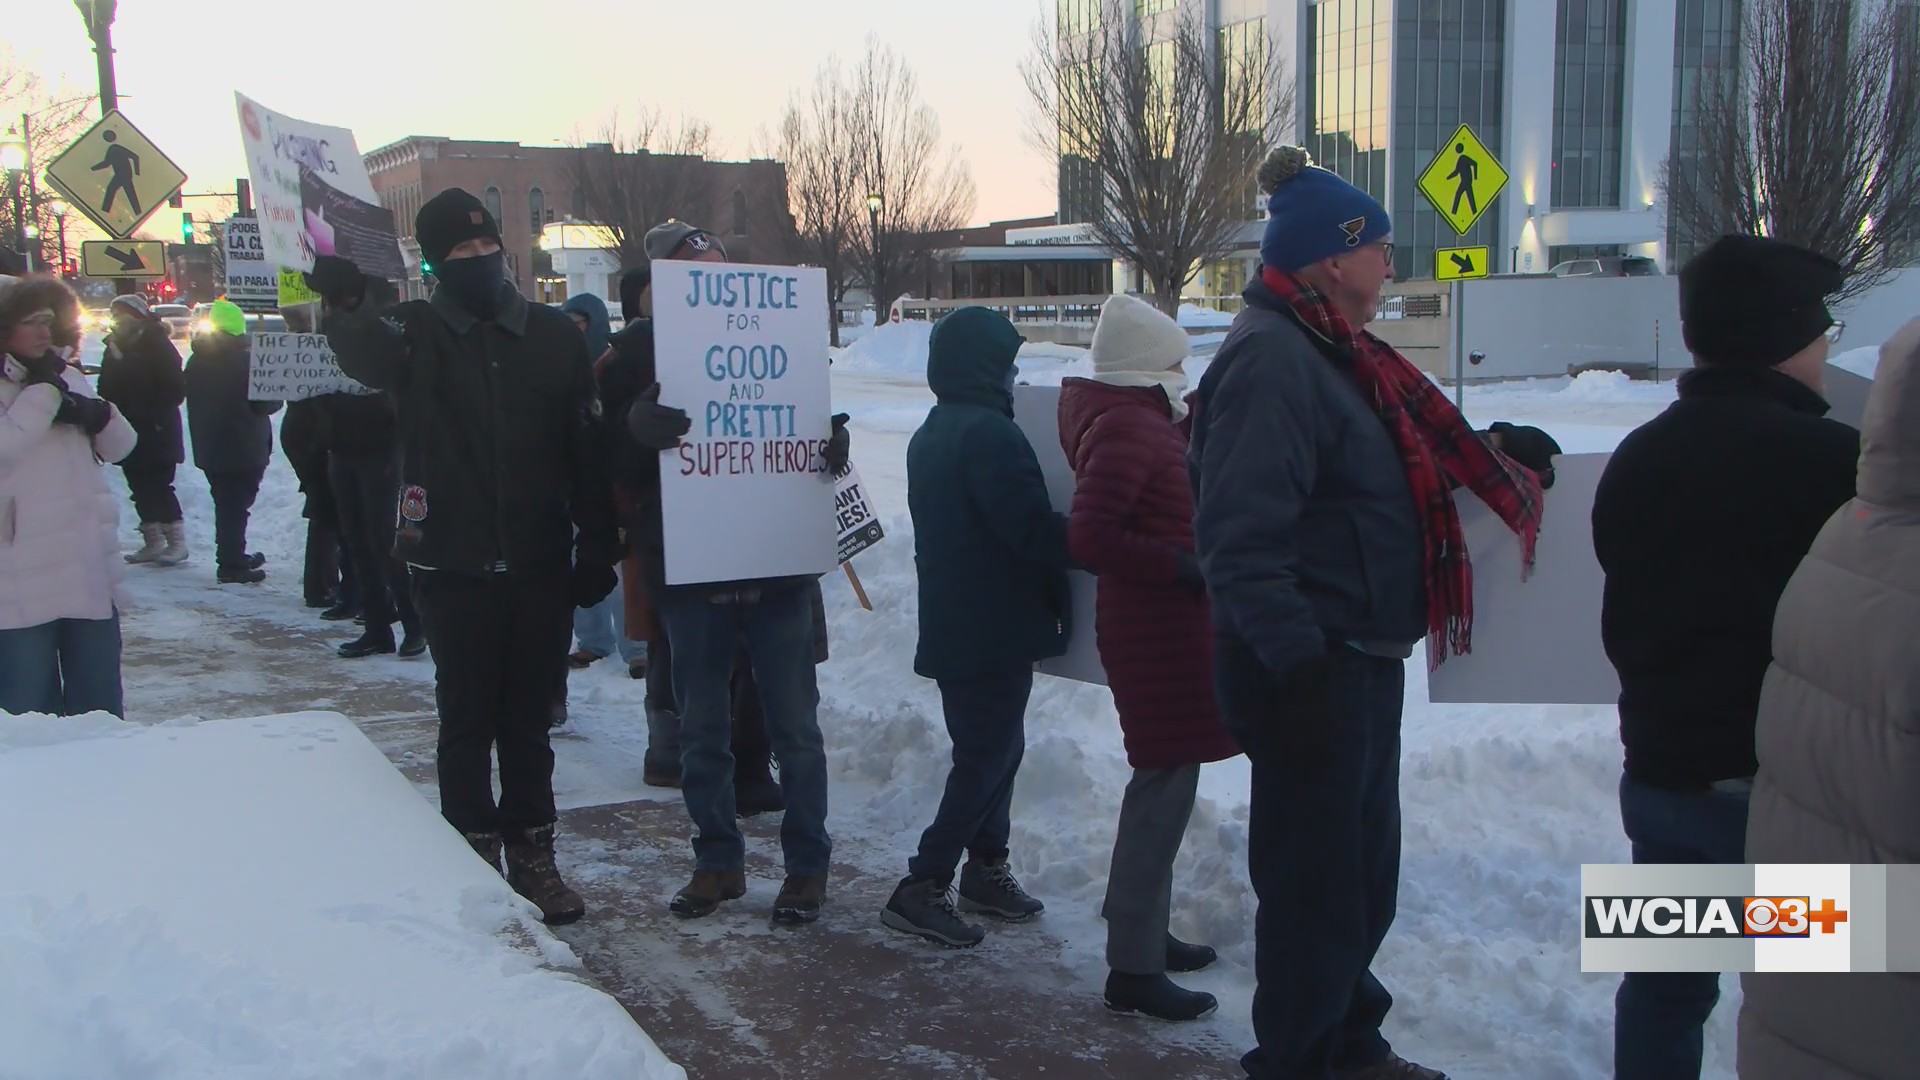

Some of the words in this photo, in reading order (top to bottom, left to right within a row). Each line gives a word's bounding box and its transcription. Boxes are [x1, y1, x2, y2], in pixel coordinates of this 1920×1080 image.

[229, 235, 245, 250] LA
[249, 235, 263, 250] CL
[229, 275, 242, 287] NO
[244, 276, 269, 287] PARA
[686, 270, 798, 309] JUSTICE
[727, 313, 760, 331] FOR
[255, 334, 288, 348] THE
[256, 352, 289, 367] YOU
[294, 352, 313, 364] TO
[705, 345, 788, 382] GOOD
[253, 383, 288, 394] YOUR
[296, 383, 331, 398] EYES
[729, 383, 764, 400] AND
[706, 401, 796, 438] PRETTI
[679, 441, 754, 477] SUPER
[763, 439, 829, 474] HEROES
